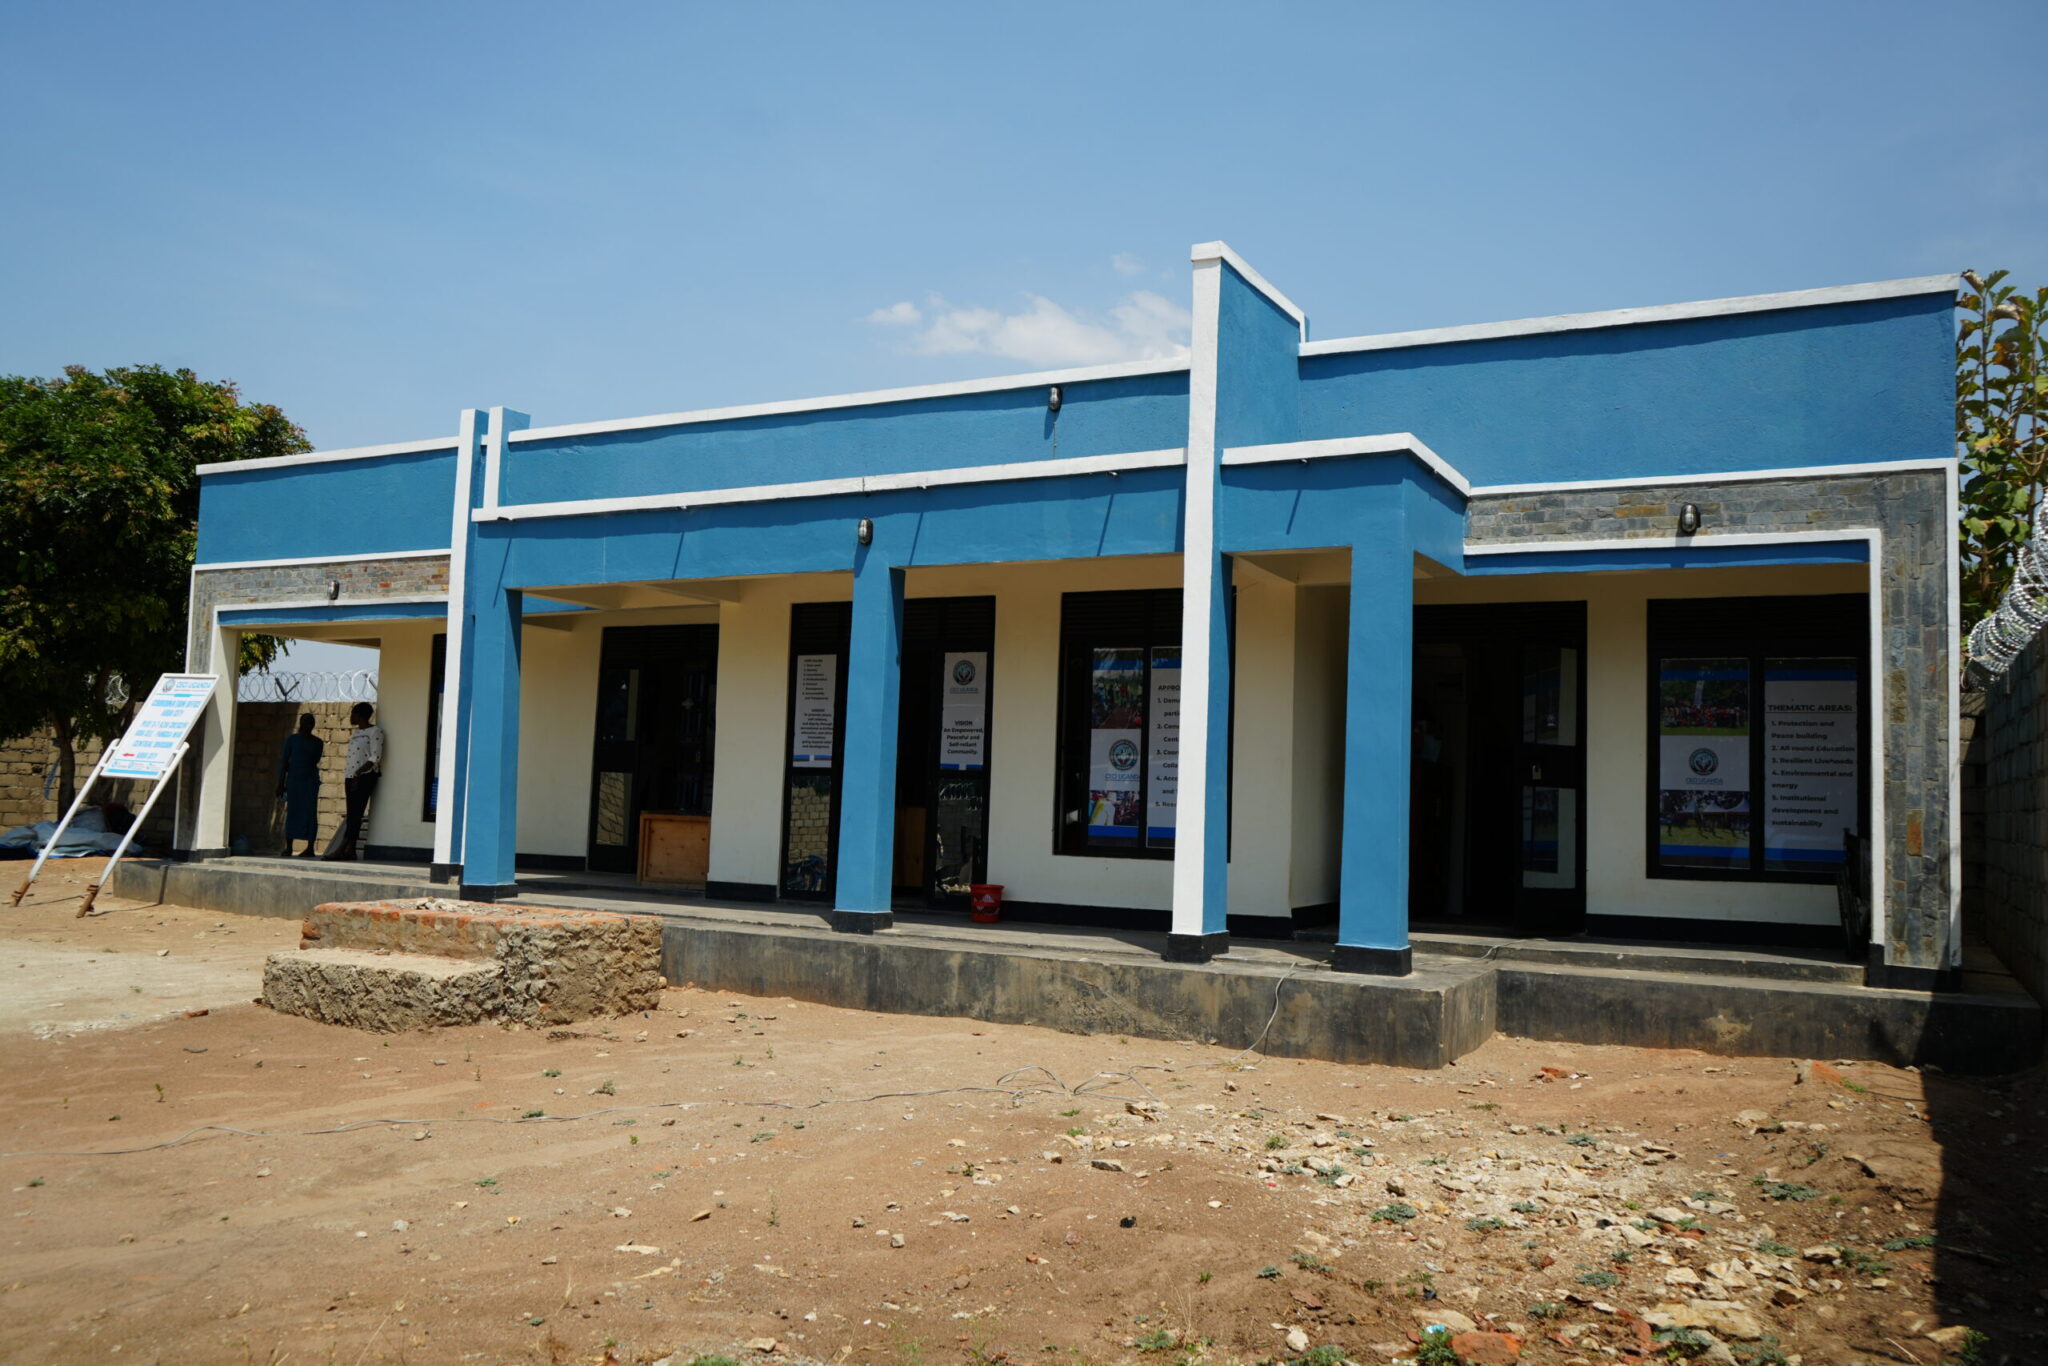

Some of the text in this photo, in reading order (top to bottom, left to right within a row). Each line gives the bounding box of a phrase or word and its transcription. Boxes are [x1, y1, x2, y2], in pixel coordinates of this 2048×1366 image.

[1768, 704, 1853, 712] THEMATIC AREAS:
[1796, 732, 1828, 740] building
[1772, 820, 1823, 828] sustainability
